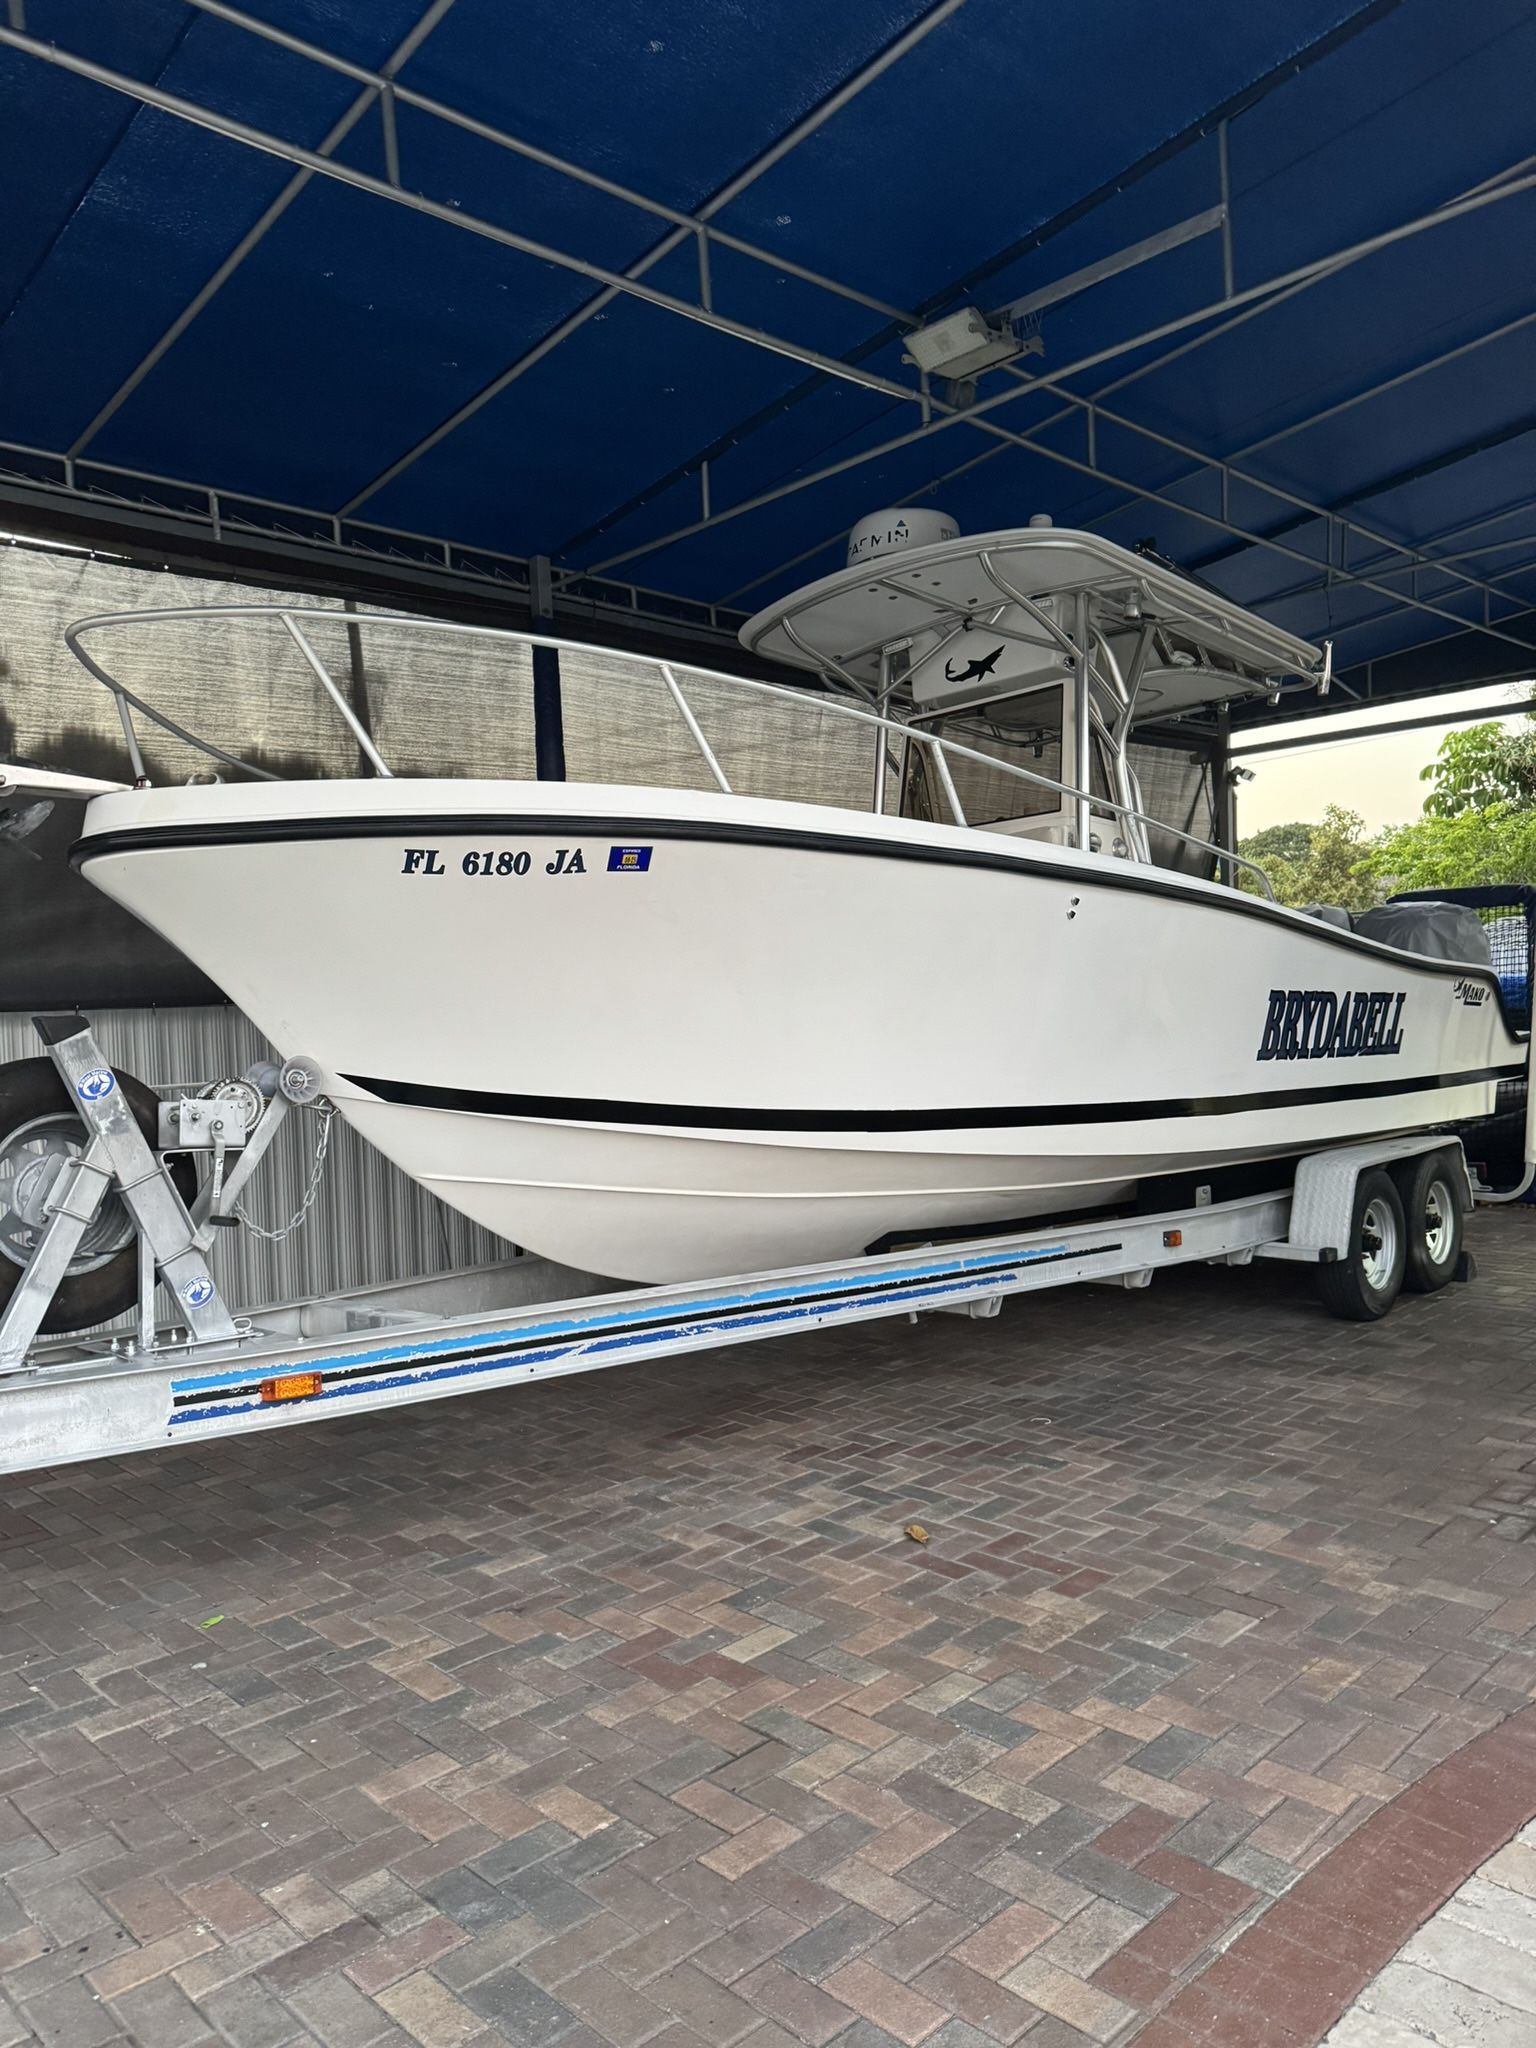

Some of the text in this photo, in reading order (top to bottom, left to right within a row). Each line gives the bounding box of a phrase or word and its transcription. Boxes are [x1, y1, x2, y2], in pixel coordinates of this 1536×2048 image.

[401, 848, 587, 876] FL 6180 JA
[1256, 989, 1407, 1061] BRYDABELL
